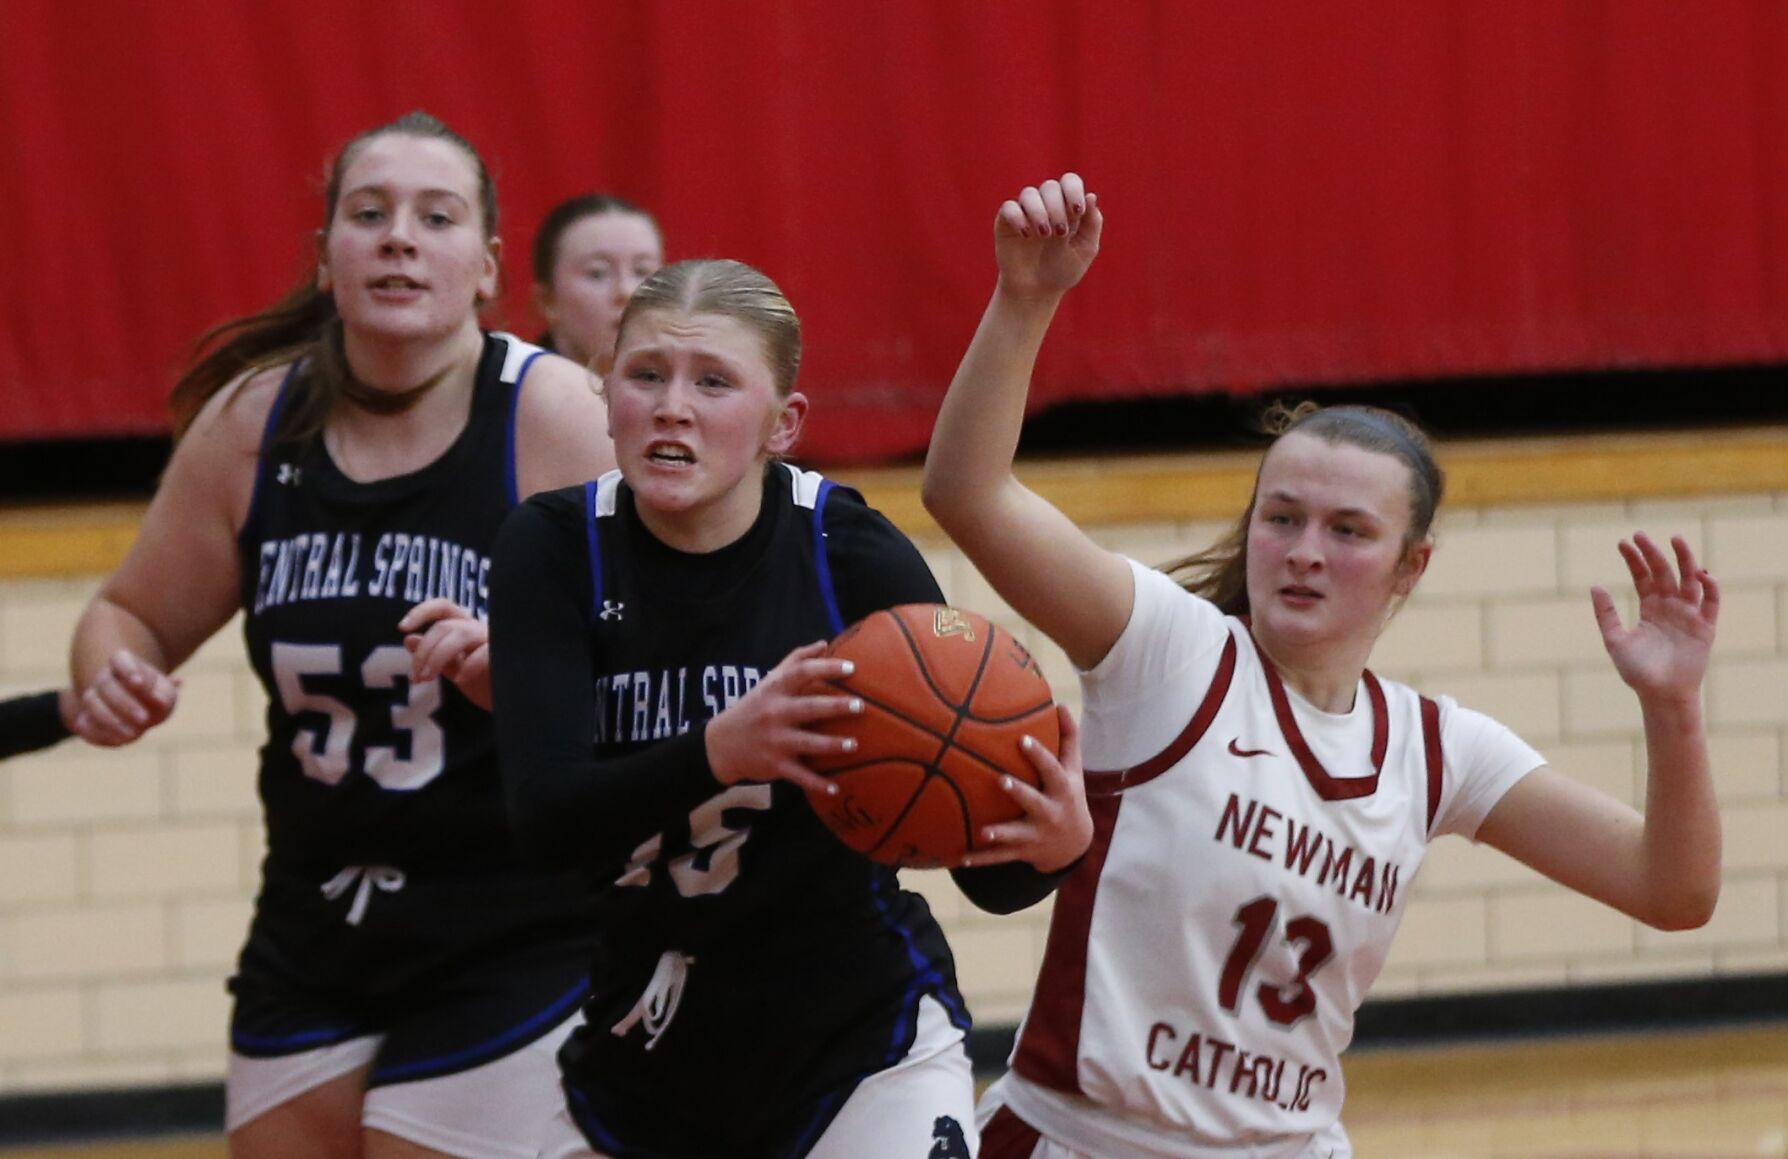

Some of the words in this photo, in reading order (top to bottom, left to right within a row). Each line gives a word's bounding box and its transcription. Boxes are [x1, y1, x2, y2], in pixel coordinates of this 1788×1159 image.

[254, 533, 361, 616] ENTRAL
[368, 533, 492, 622] SPRINGS
[270, 641, 446, 792] 53
[594, 667, 690, 743] NTRAL
[1214, 793, 1399, 916] NEWMAN
[1218, 895, 1337, 1032] 13
[1146, 1022, 1327, 1113] CATHOLIC
